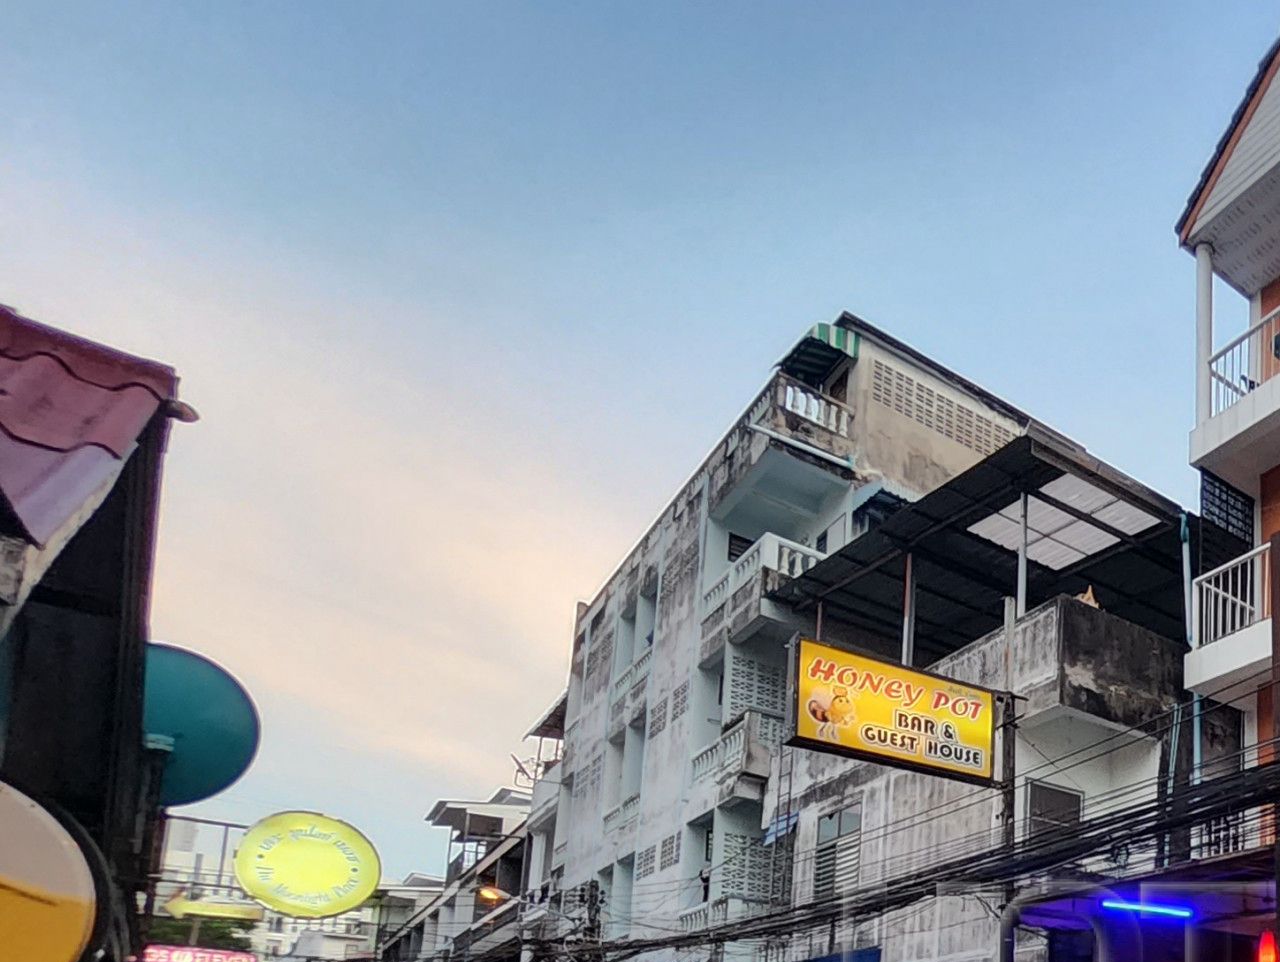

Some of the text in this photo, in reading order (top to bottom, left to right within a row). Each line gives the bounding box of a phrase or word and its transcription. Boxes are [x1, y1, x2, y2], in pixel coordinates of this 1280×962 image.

[932, 690, 984, 720] POT
[897, 711, 956, 740] BAR &
[863, 727, 981, 765] GUEST HOUSE
